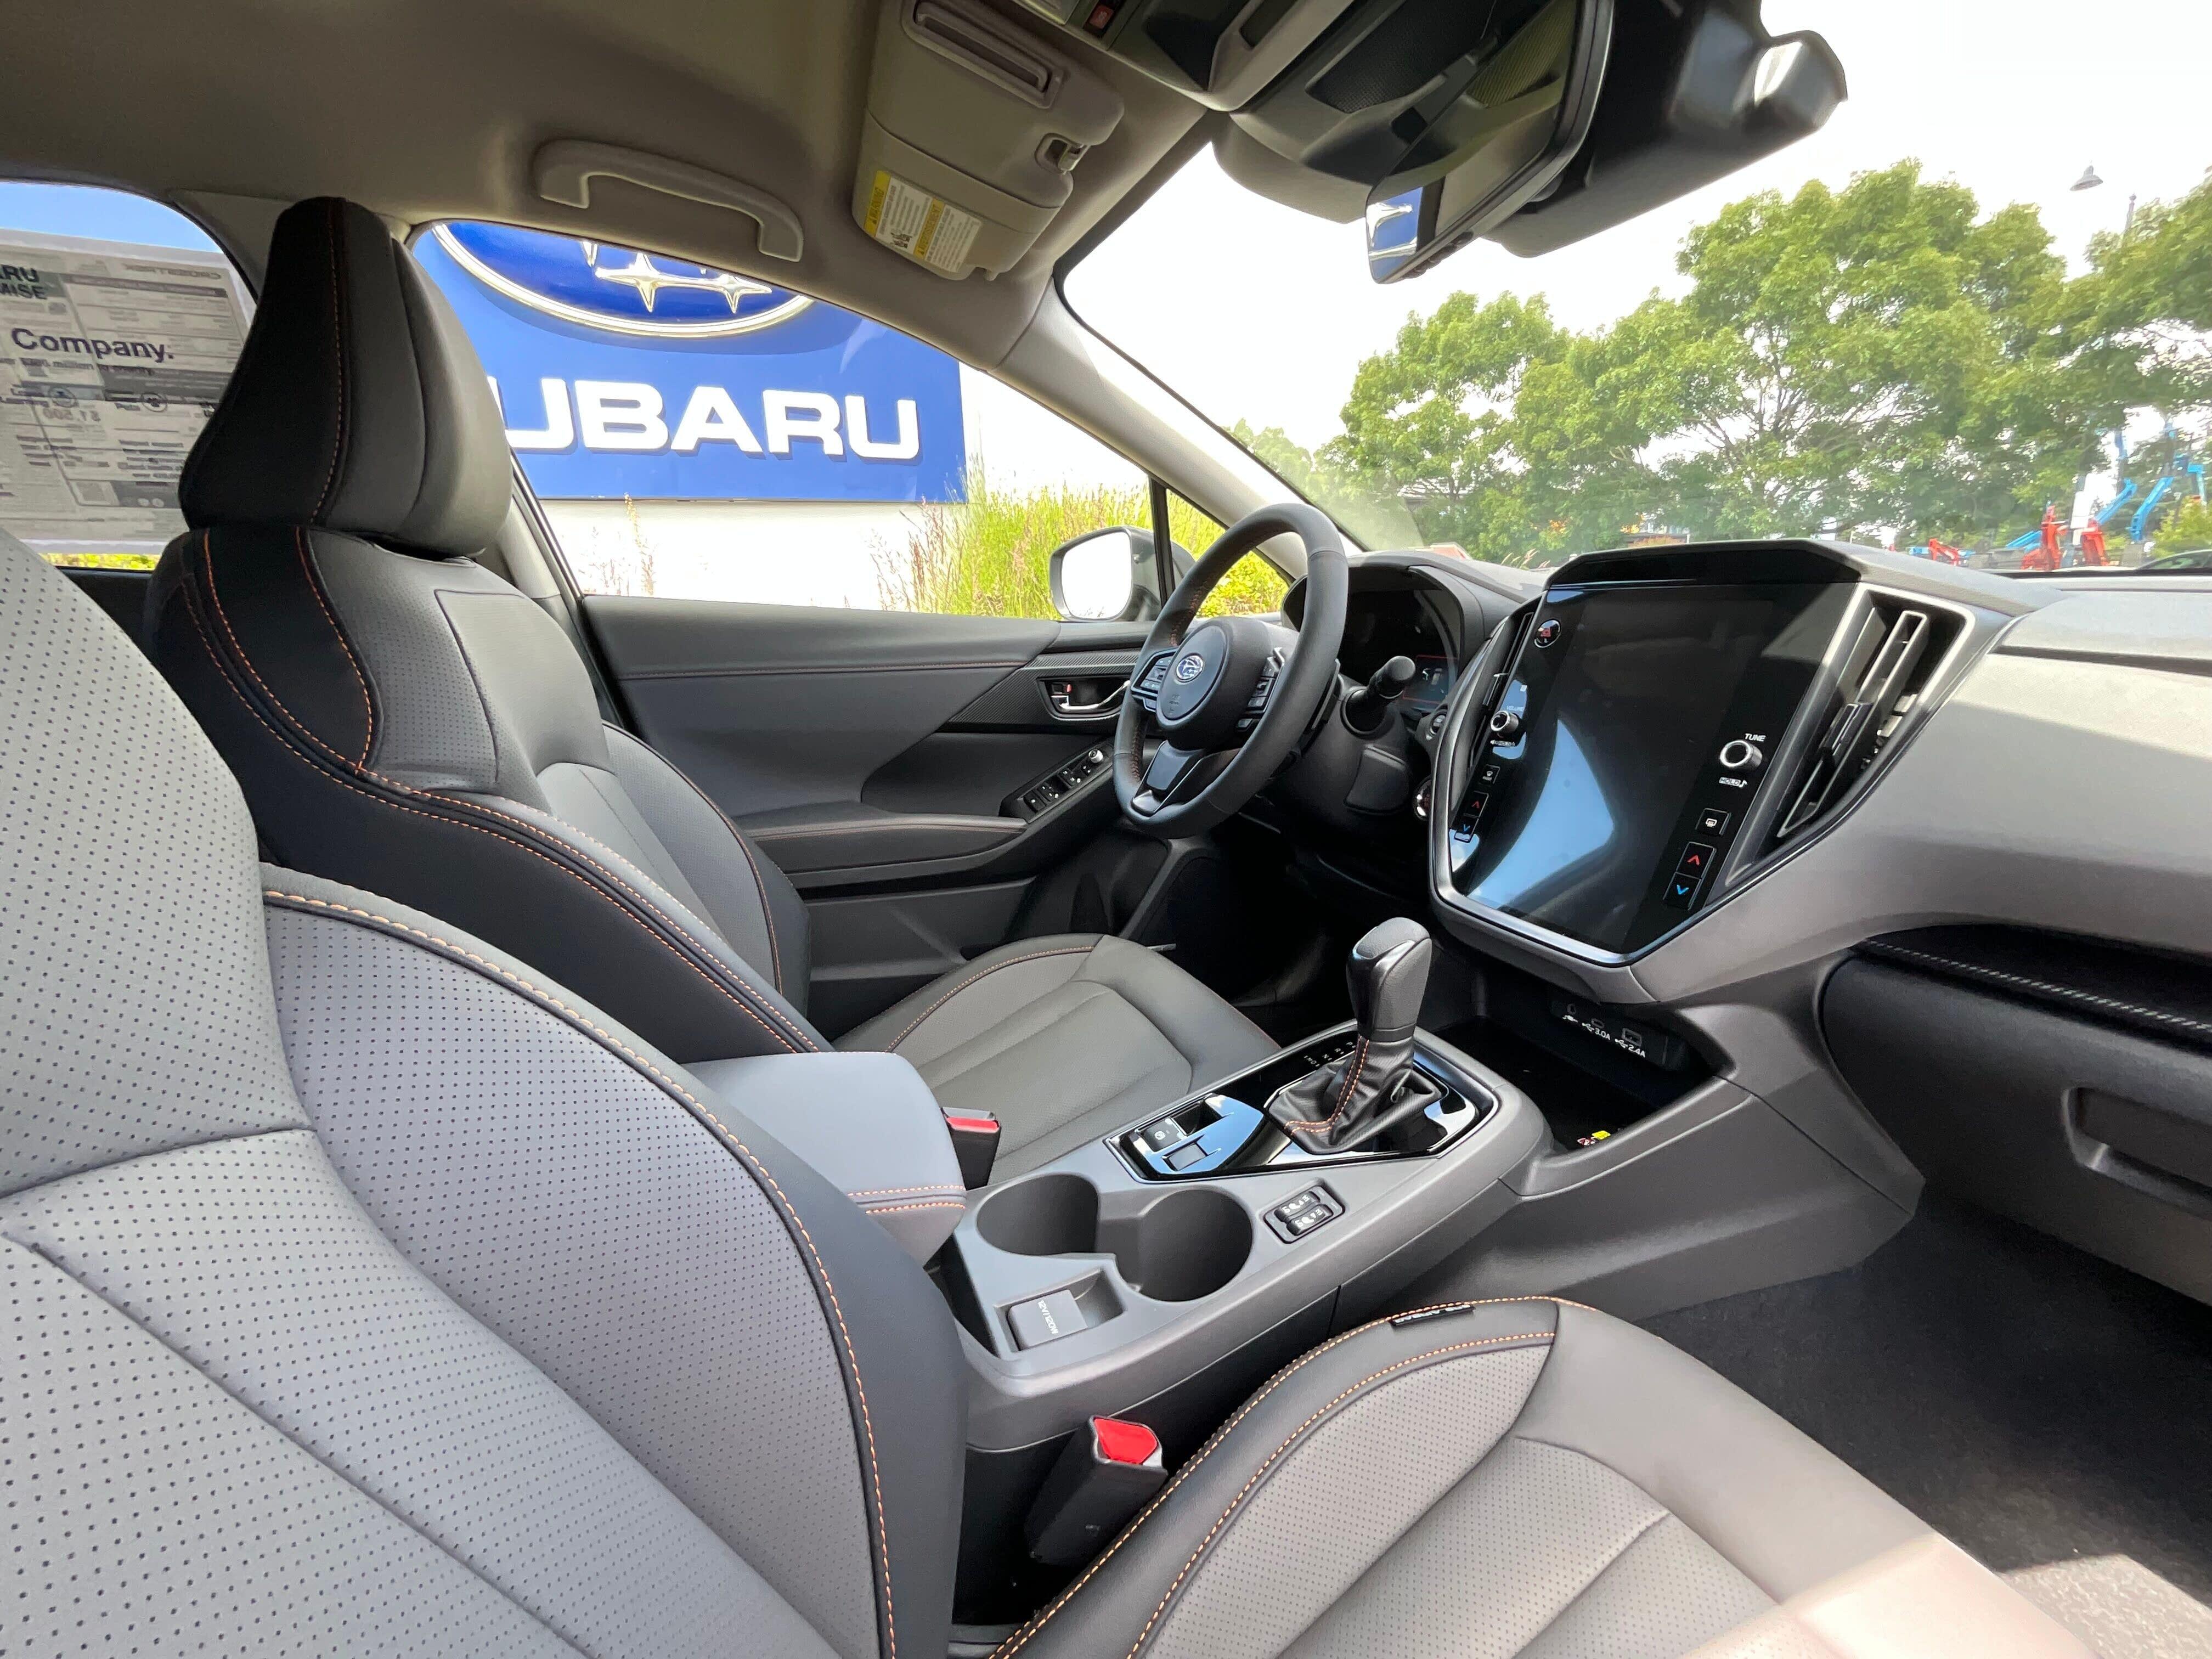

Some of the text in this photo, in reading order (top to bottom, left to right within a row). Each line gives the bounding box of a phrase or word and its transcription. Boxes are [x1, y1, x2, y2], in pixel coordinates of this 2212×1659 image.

[0, 264, 40, 283] RU
[12, 328, 174, 363] Company.
[1745, 733, 1767, 742] TUNE
[1594, 1028, 1611, 1041] 3.0A
[1628, 1043, 1646, 1058] 2.4A
